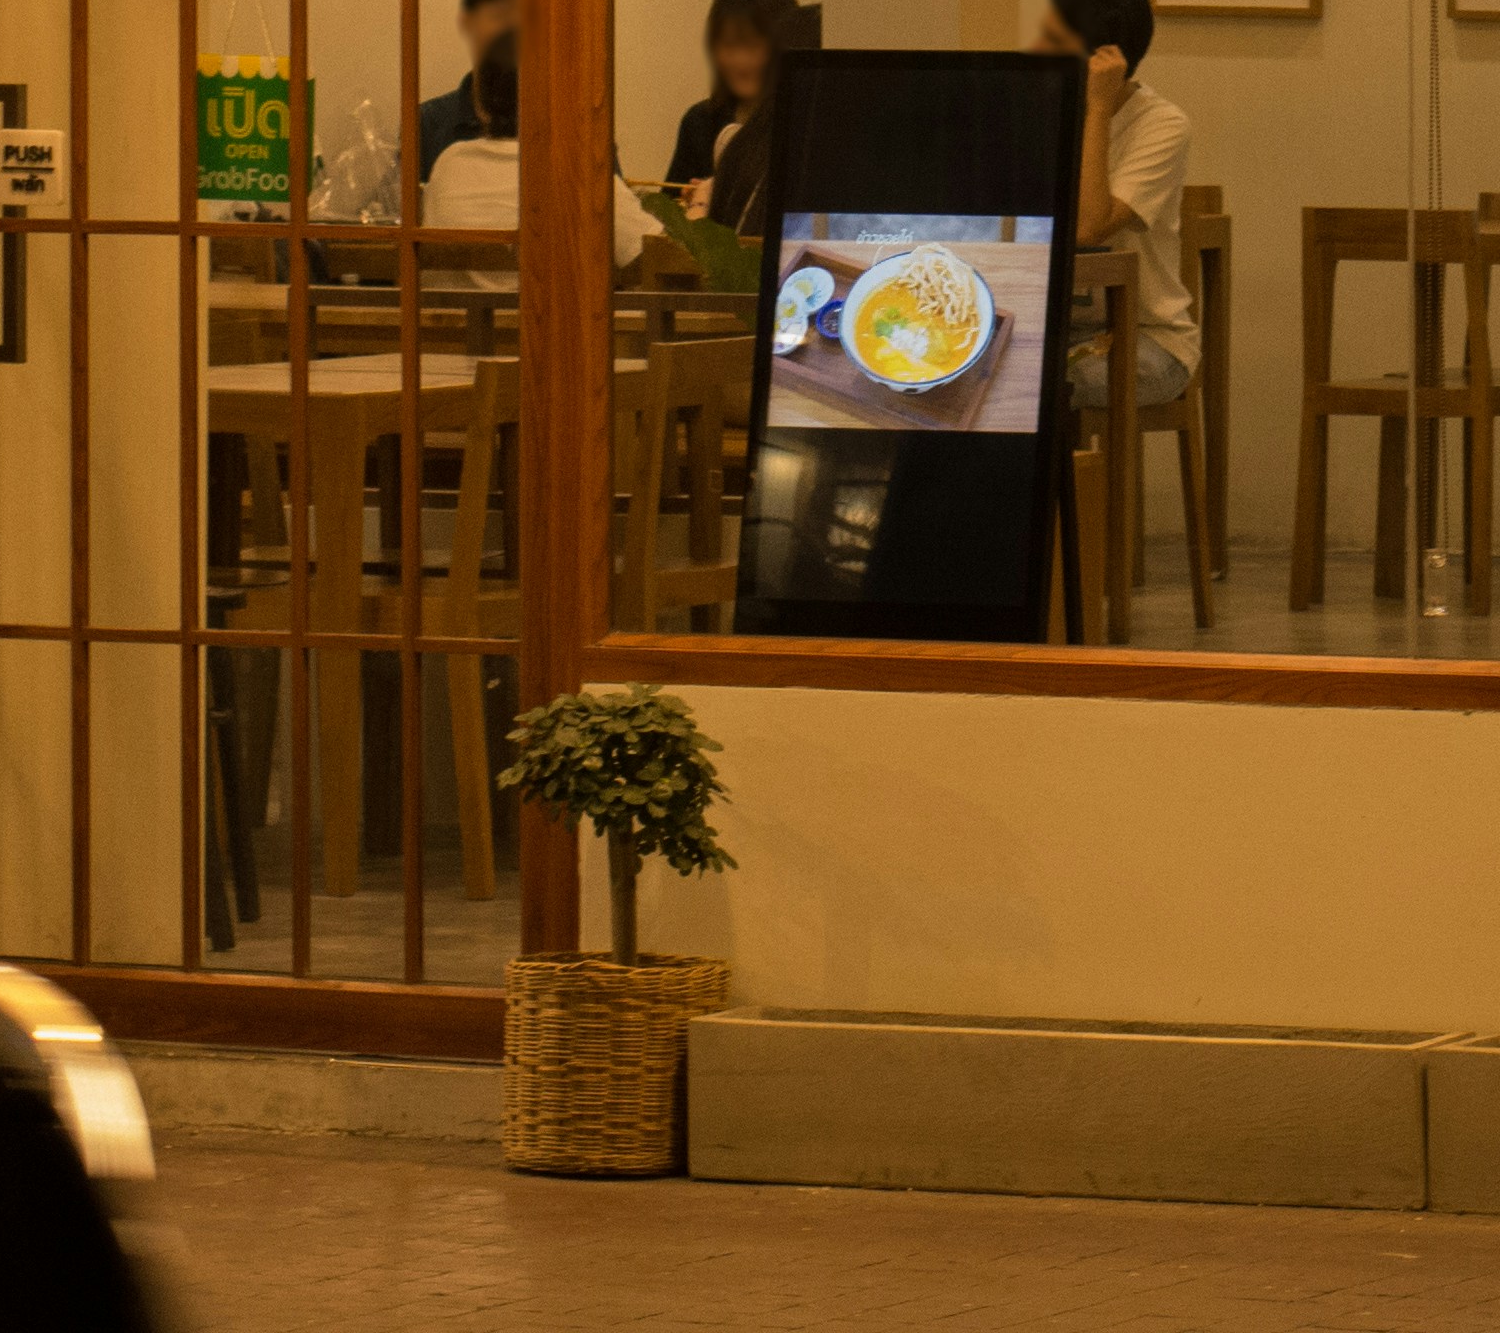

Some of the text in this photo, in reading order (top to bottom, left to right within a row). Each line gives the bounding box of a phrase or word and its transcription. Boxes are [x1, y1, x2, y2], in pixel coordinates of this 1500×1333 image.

[3, 144, 53, 163] PUSH
[224, 143, 270, 159] OPEN
[198, 165, 289, 191] GrabFoo
